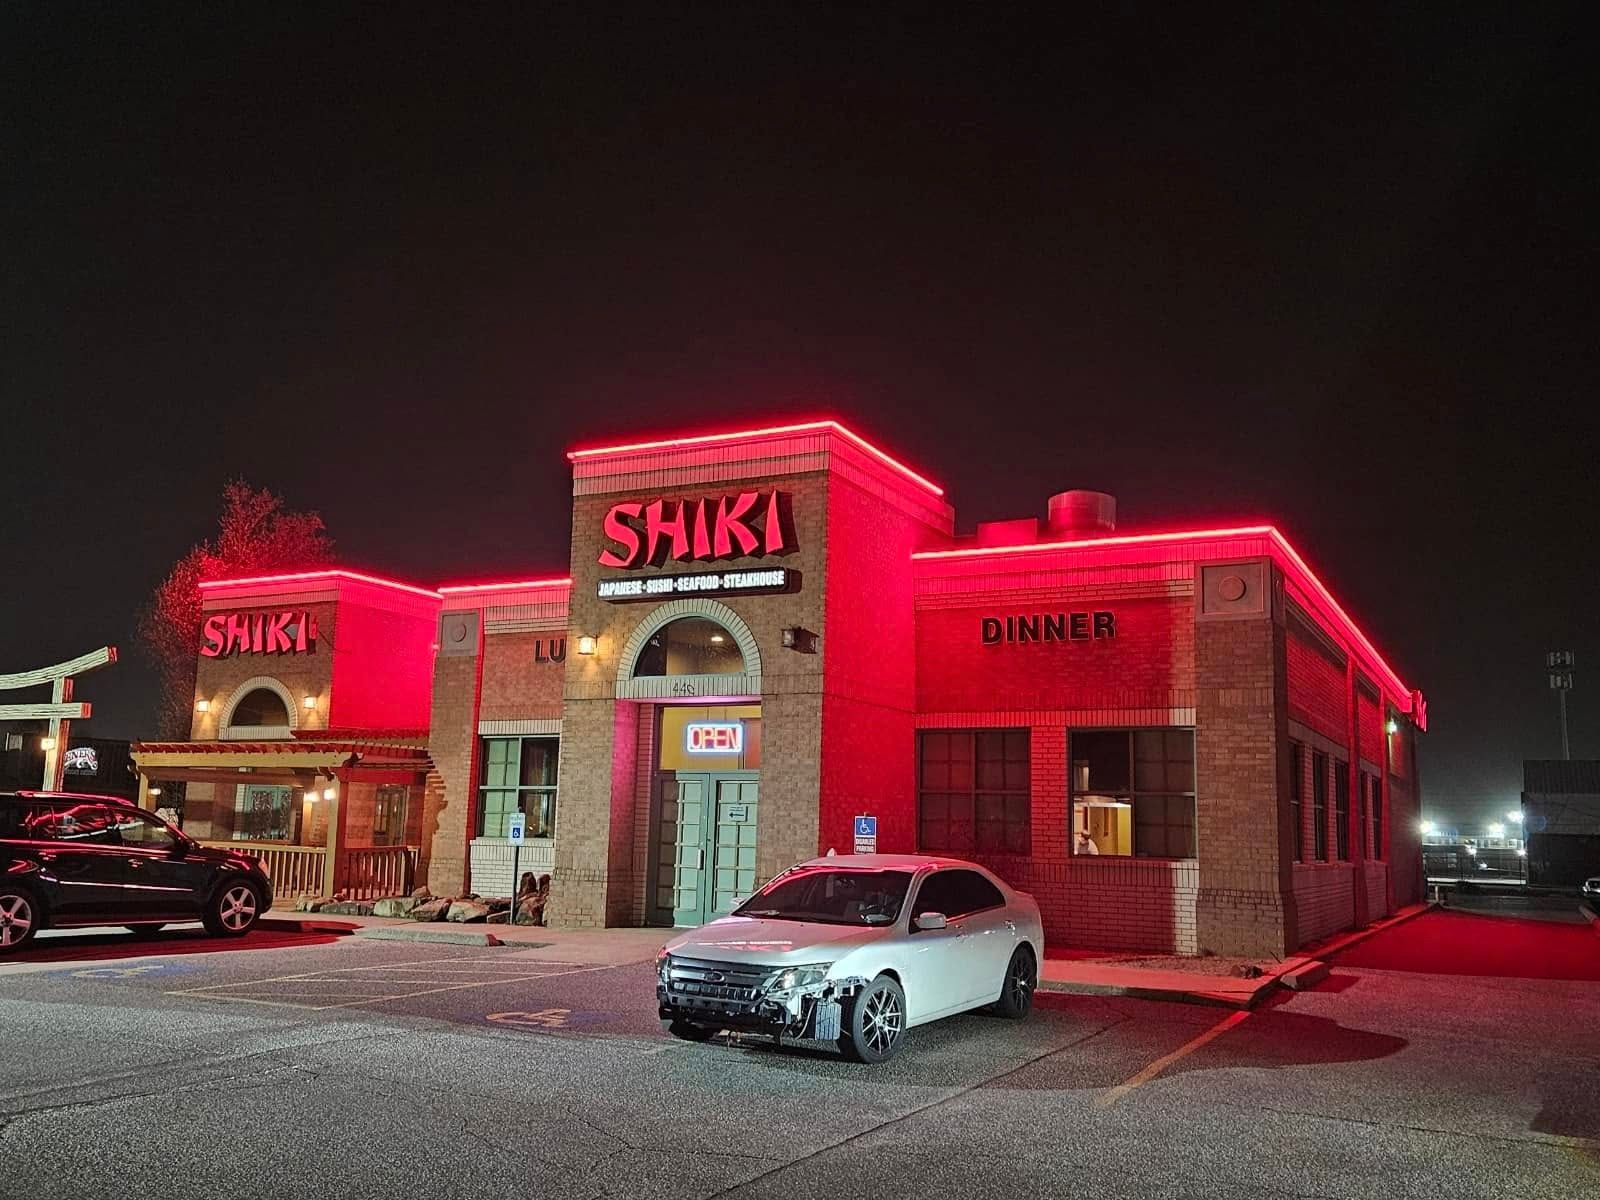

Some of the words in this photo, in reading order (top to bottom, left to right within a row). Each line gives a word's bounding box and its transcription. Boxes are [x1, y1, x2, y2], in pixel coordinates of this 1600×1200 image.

[598, 490, 784, 570] SHIKI
[597, 581, 643, 598] JAPANESE
[646, 578, 674, 594] SUSHI
[677, 575, 719, 592] SEAFOOD
[723, 570, 785, 588] STEAKHOUSE
[200, 612, 308, 657] SHIKI
[981, 611, 1116, 645] DINNER
[689, 727, 738, 749] OPEN
